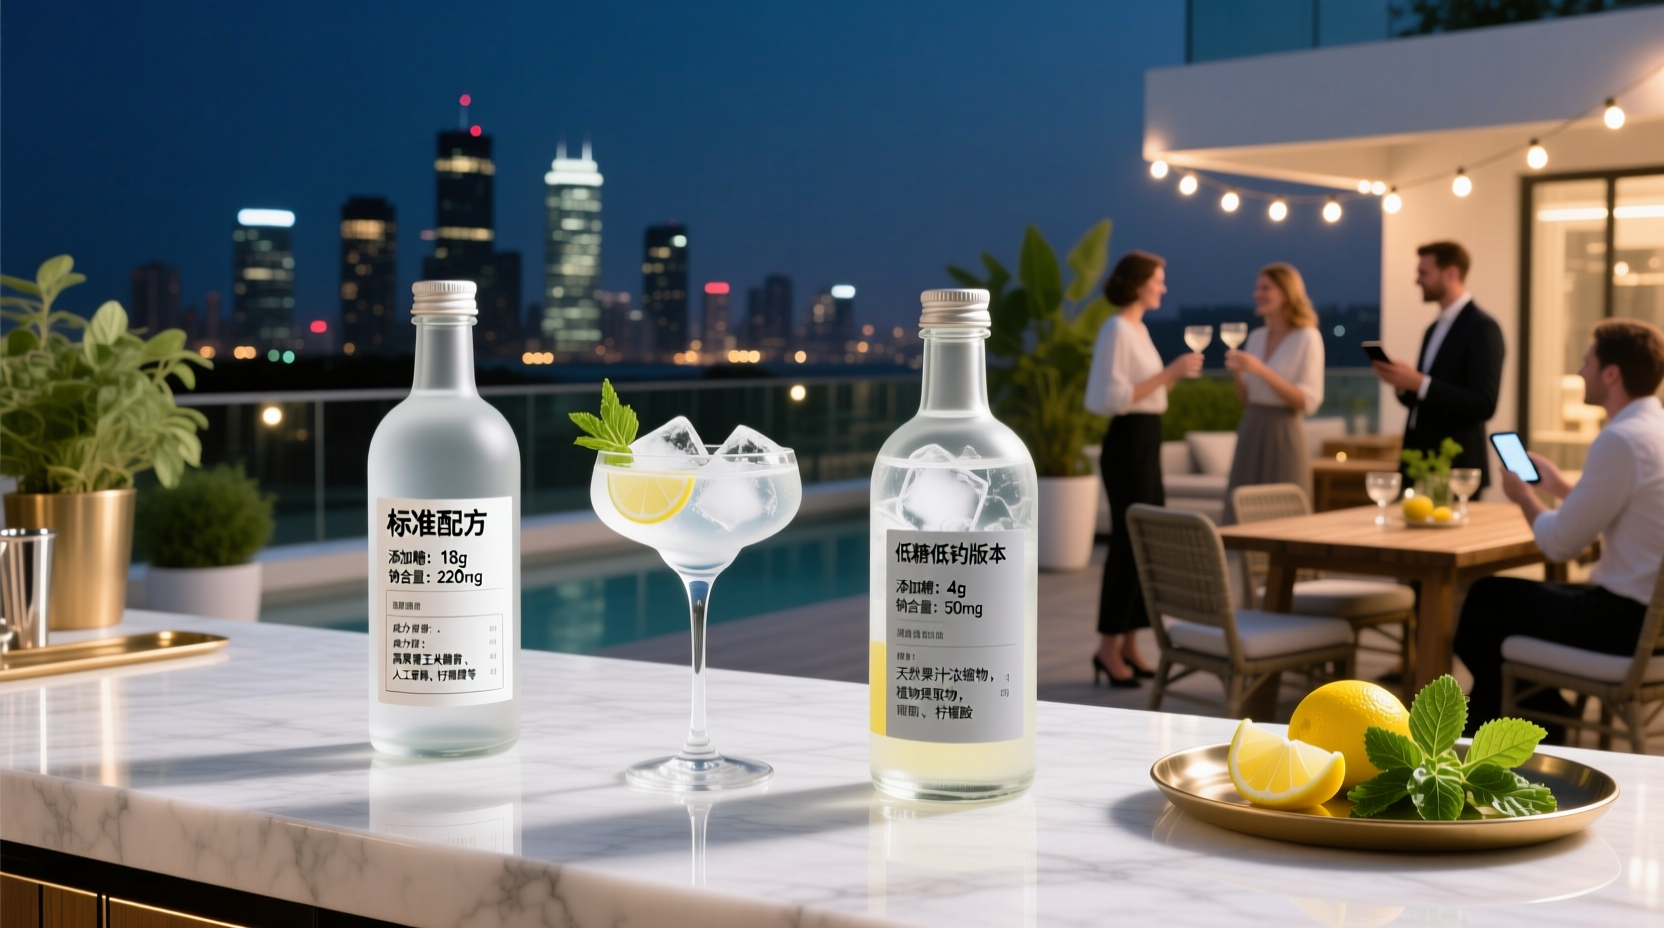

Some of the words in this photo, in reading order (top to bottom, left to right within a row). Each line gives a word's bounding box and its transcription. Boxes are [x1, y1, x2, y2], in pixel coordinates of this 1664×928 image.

[387, 508, 487, 537] 标准配方
[441, 549, 468, 568] 18g
[946, 580, 967, 598] 4g
[944, 600, 983, 618] 50mg
